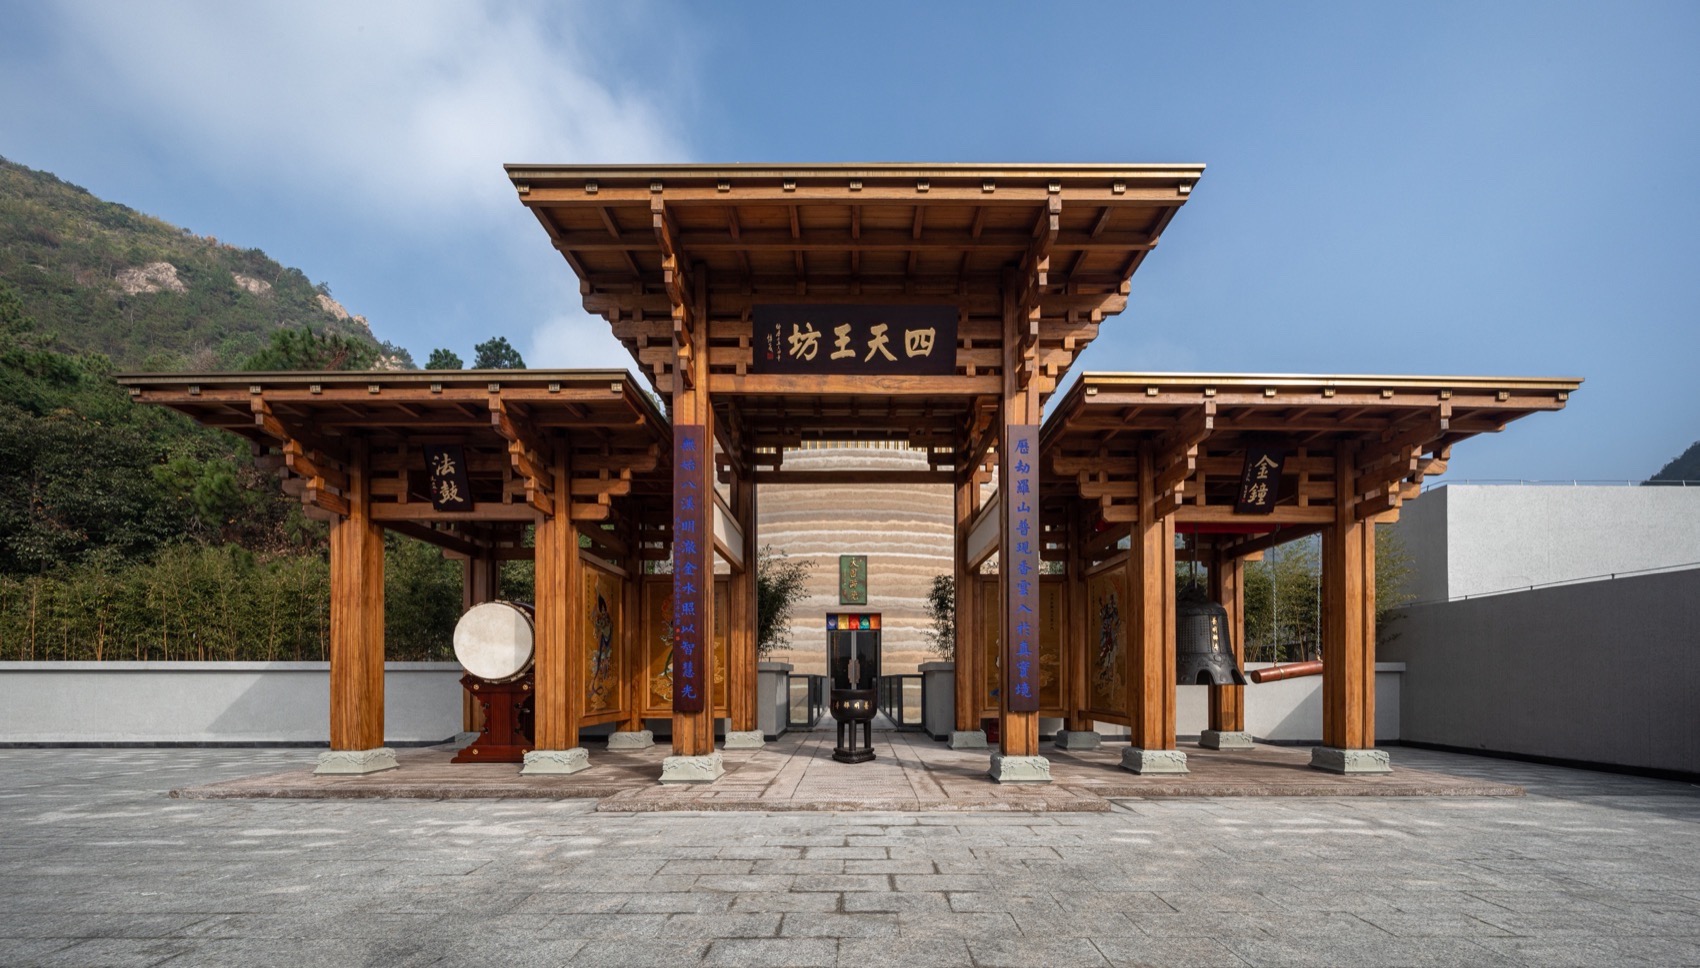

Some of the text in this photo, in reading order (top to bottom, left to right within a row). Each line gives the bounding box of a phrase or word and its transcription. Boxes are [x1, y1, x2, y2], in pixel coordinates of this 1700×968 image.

[787, 322, 936, 363] 四天王坊
[431, 453, 464, 504] 法鼓
